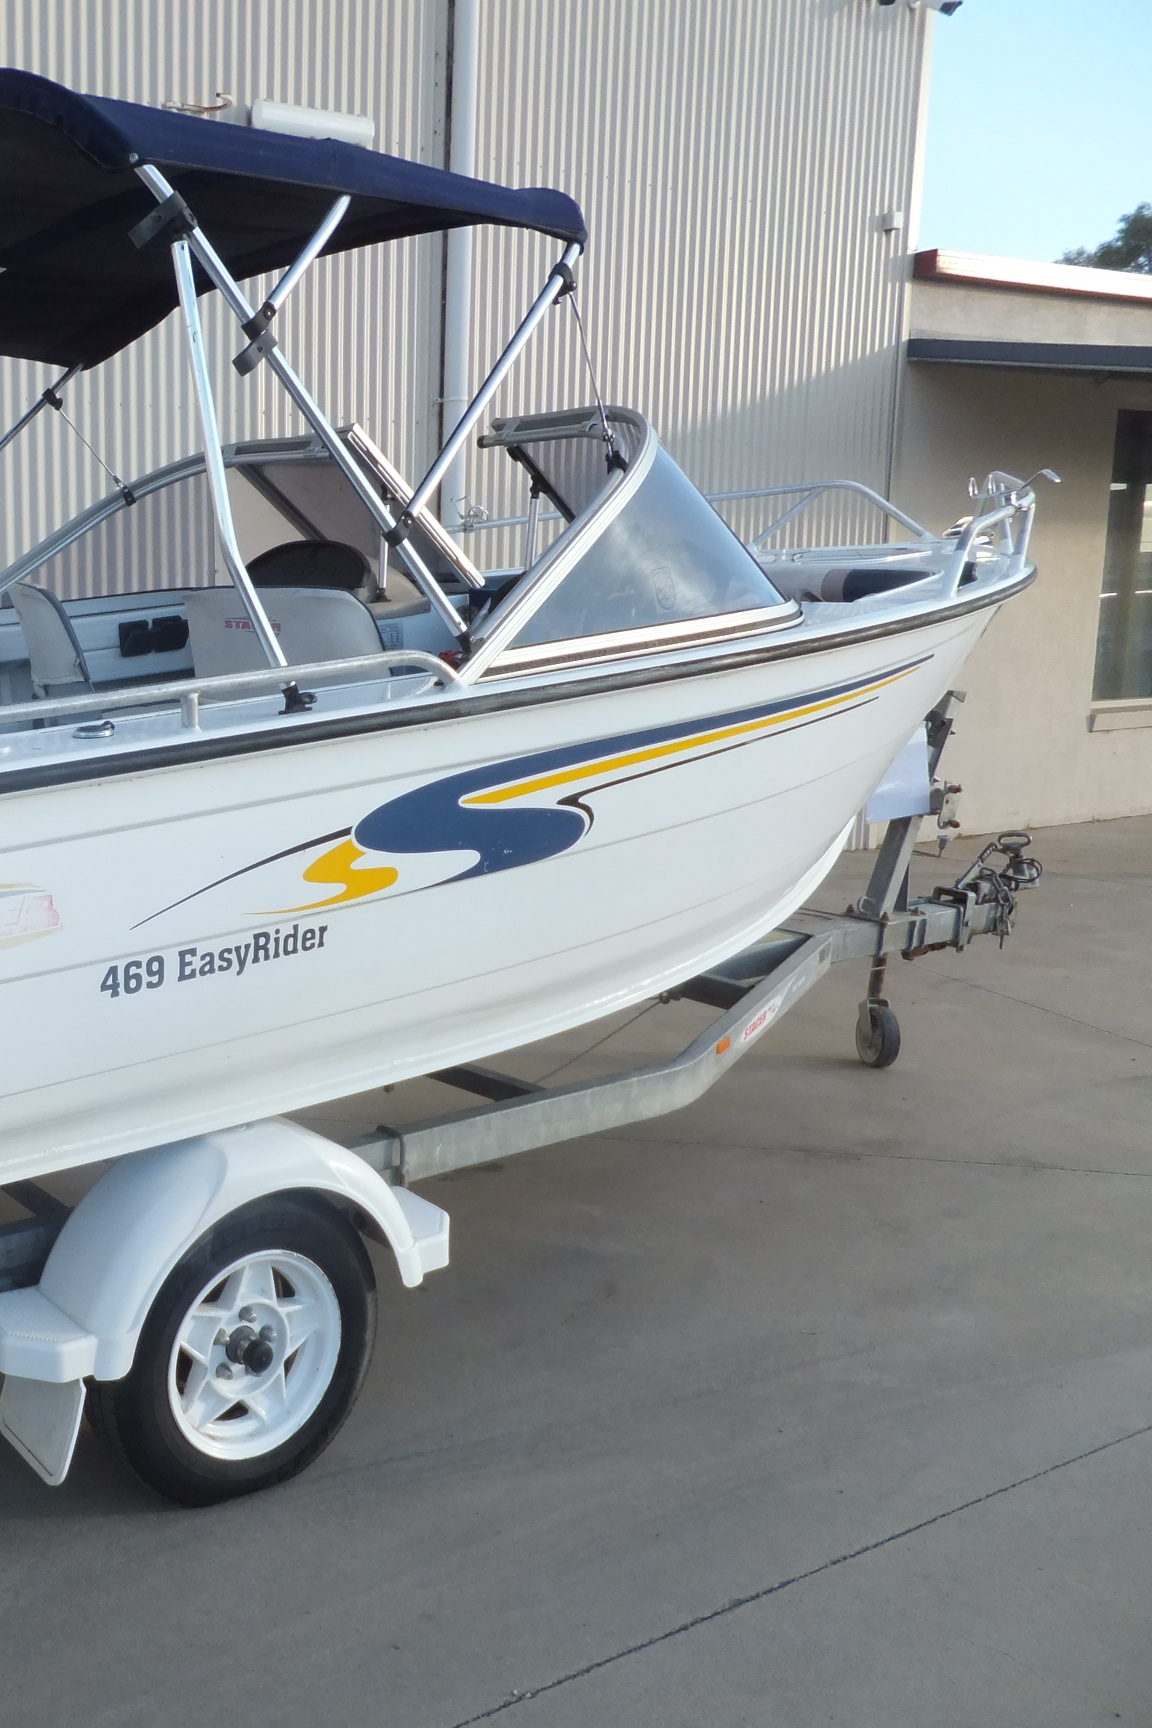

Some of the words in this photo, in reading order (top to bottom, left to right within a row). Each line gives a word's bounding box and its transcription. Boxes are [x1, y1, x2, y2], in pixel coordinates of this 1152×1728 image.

[224, 620, 282, 633] STAR
[100, 954, 166, 998] 469
[179, 922, 328, 982] EasyRider
